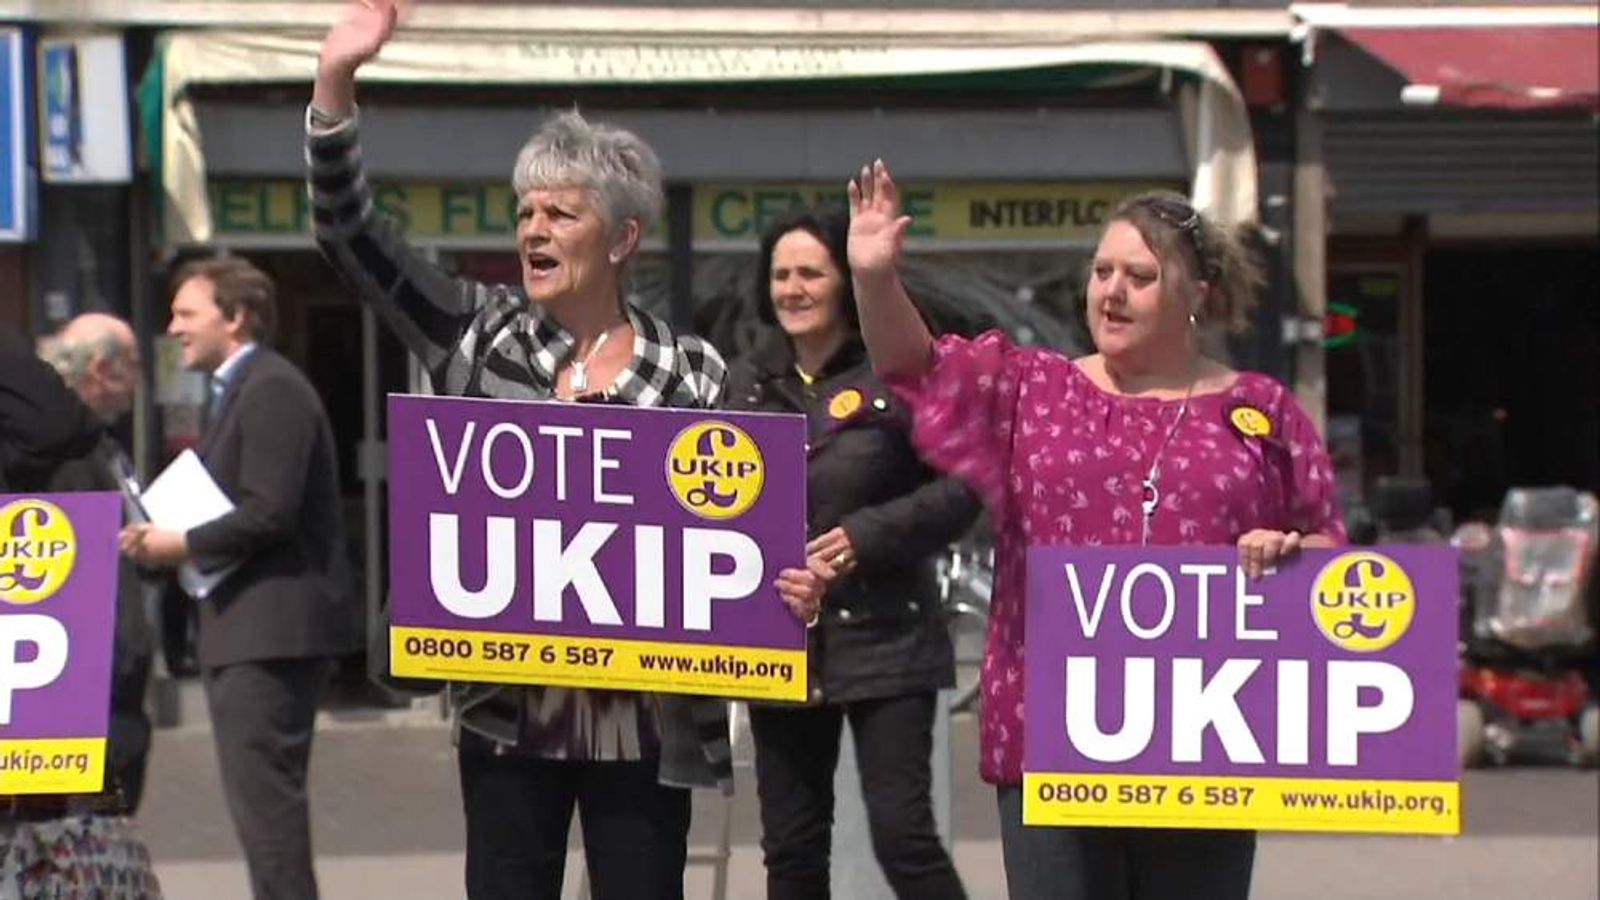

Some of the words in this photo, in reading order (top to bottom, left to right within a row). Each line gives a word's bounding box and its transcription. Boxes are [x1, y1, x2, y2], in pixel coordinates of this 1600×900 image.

[426, 418, 634, 505] VOTE
[672, 457, 757, 479] UKIP
[429, 512, 764, 631] UKIP
[1065, 562, 1279, 640] VOTE
[1319, 592, 1407, 608] UKIP
[405, 637, 473, 658] 0800
[482, 642, 531, 662] 587
[540, 645, 556, 664] 6
[565, 647, 614, 667] 587
[638, 653, 793, 682] www.ukip.org
[1065, 656, 1415, 766] UKIP
[1038, 783, 1108, 803] 0800
[1117, 785, 1167, 805] 587
[1177, 786, 1195, 806] 6
[1204, 787, 1255, 806] 587
